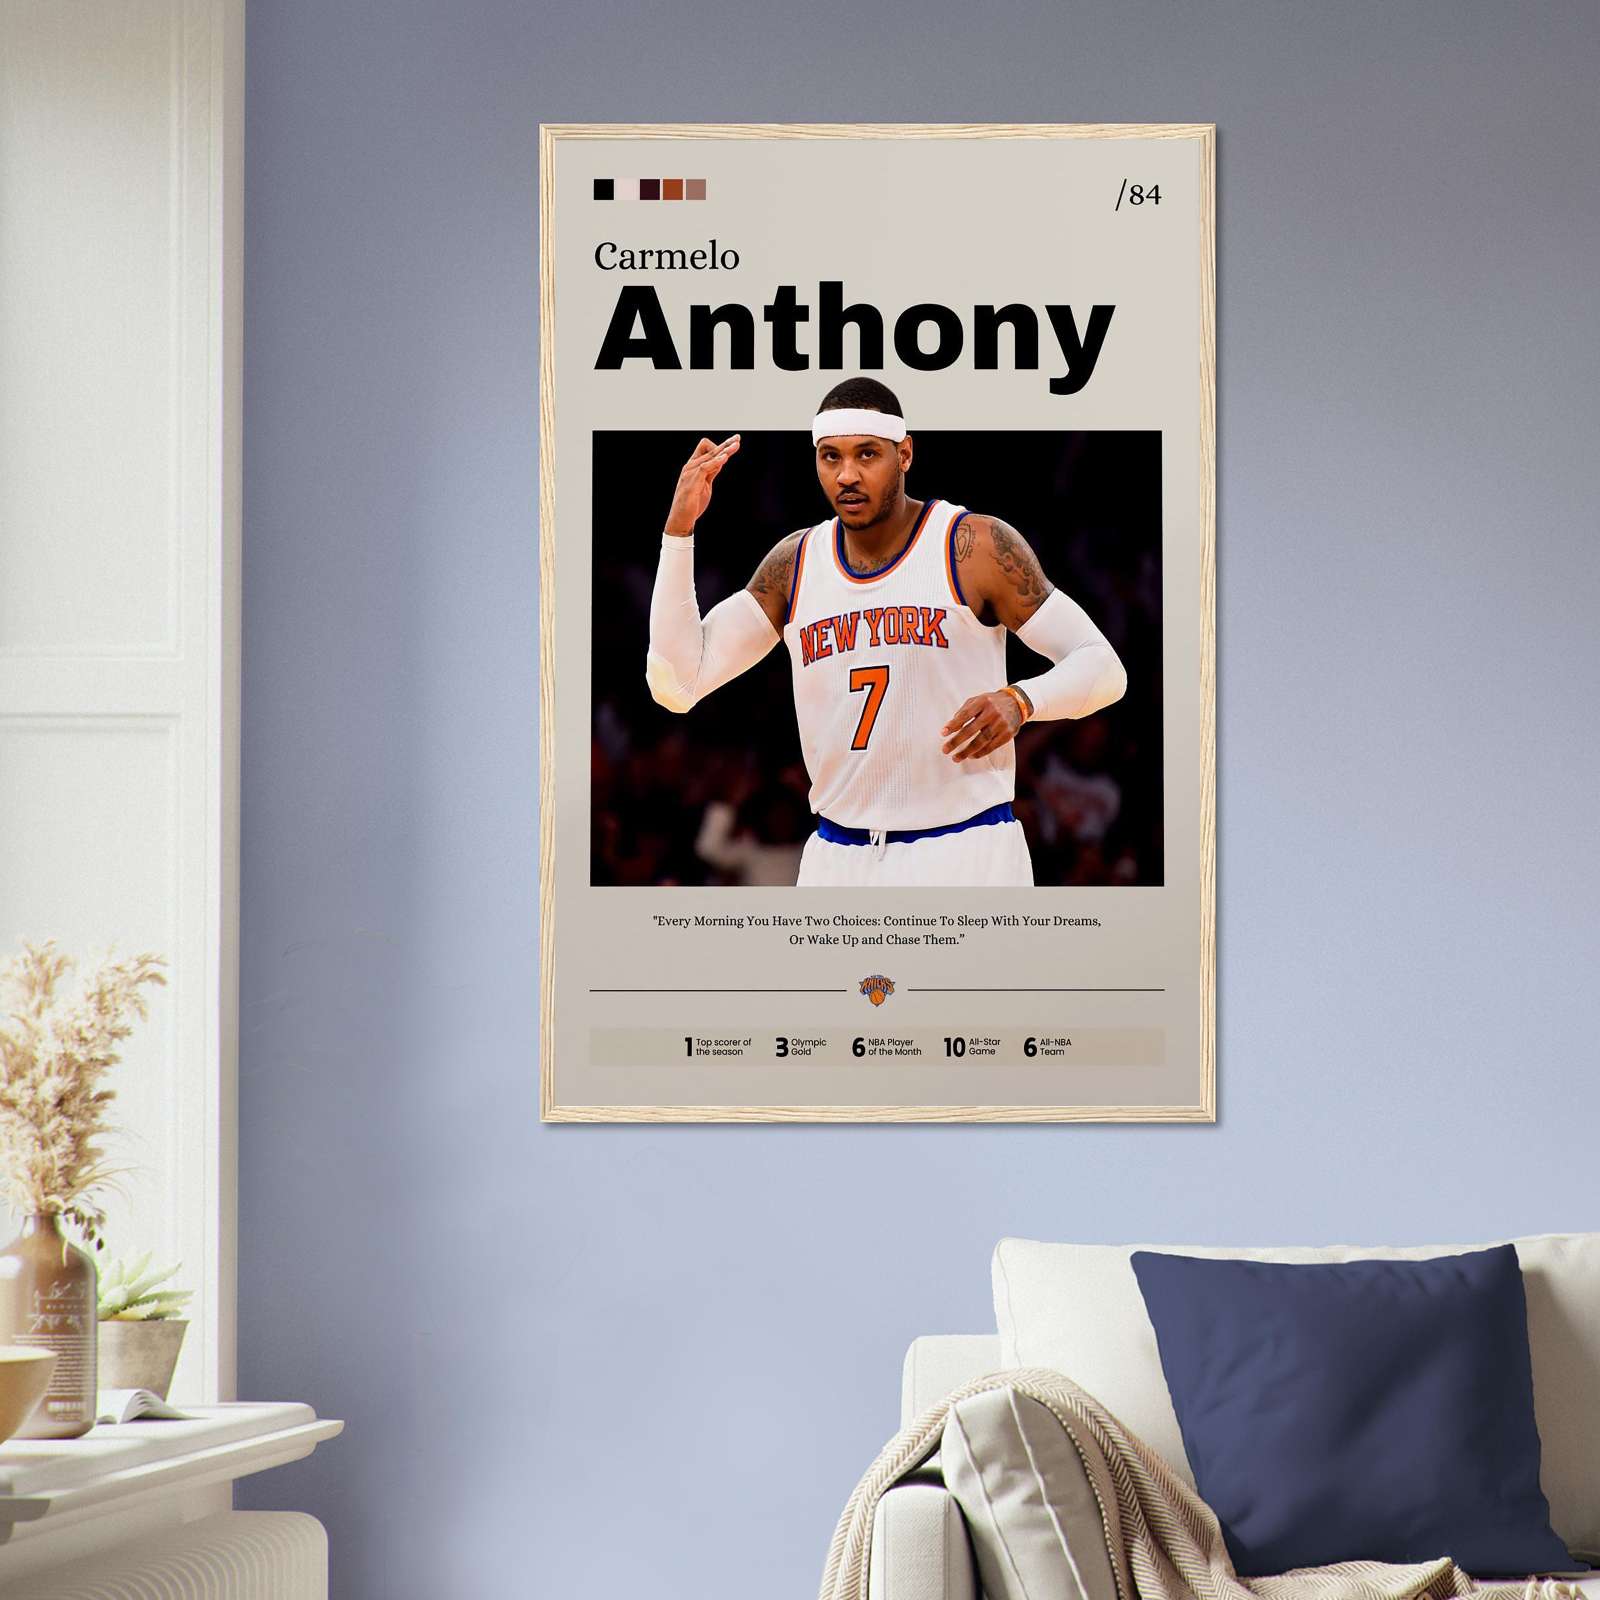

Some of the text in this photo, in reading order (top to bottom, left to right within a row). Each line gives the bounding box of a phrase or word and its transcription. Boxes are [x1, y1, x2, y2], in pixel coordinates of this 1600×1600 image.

[1114, 177, 1163, 212] /84
[594, 238, 740, 271] Carmelo
[594, 281, 1116, 396] Anthony
[800, 606, 949, 667] NEW YORK
[850, 665, 890, 750] 7
[694, 914, 745, 929] Morning
[746, 914, 770, 927] You
[772, 914, 803, 927] Have
[804, 914, 831, 927] Two
[832, 914, 881, 927] Choices:
[883, 914, 937, 927] Continue
[939, 914, 955, 927] To
[957, 914, 989, 929] Sleep
[990, 914, 1020, 927] With
[1021, 914, 1051, 927] Your
[1053, 914, 1102, 928] Dreams,
[789, 933, 805, 945] Or
[806, 933, 840, 945] Wake
[841, 933, 860, 948] Up
[861, 933, 884, 945] and
[885, 933, 921, 945] Chase
[684, 1036, 693, 1057] 1
[695, 1038, 713, 1048] Top
[742, 1038, 753, 1046] of
[775, 1036, 790, 1058] 3
[790, 1038, 828, 1047] Olympic
[851, 1036, 866, 1058] 6
[867, 1038, 914, 1048] NBA Player
[943, 1036, 967, 1058] 10
[968, 1038, 1002, 1046] All-Star
[1023, 1036, 1039, 1058] 6
[1039, 1038, 1073, 1046] All-NBA
[695, 1047, 744, 1056] the season
[790, 1047, 813, 1056] Gold
[867, 1047, 923, 1056] of the Month
[968, 1047, 997, 1056] Game
[1039, 1047, 1066, 1056] Team
